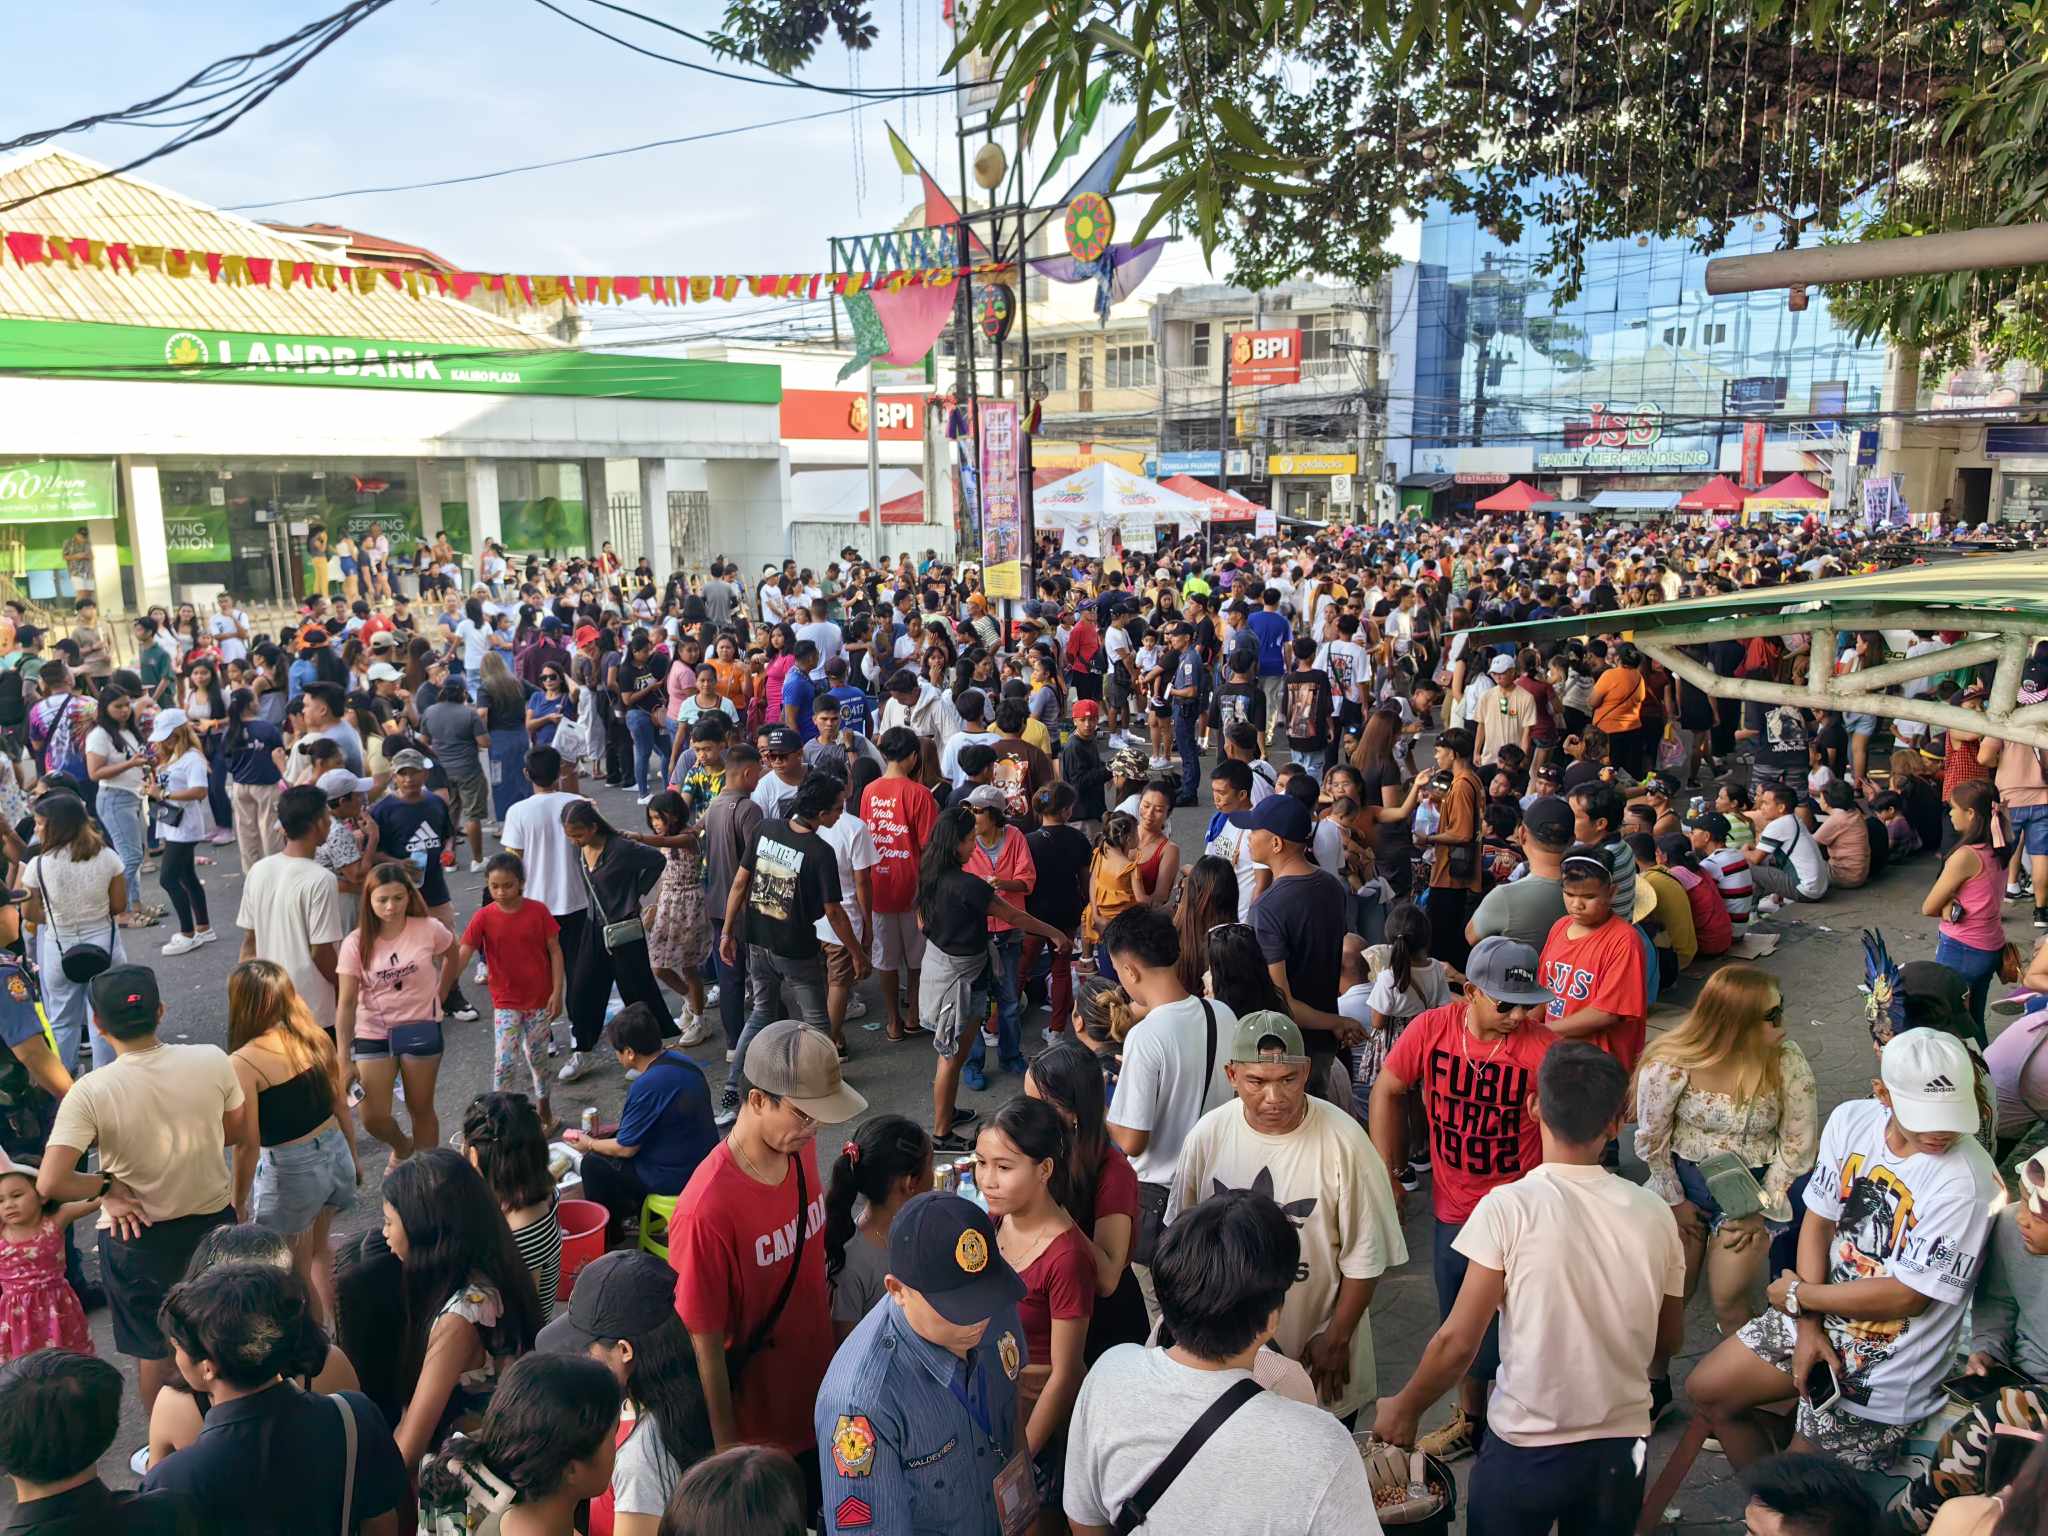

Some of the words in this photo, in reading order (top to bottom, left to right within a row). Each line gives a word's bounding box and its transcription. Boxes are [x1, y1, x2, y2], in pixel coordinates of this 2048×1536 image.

[1252, 336, 1289, 359] BPI
[218, 340, 442, 380] LANDBANK
[450, 369, 488, 382] KALIBO
[489, 371, 521, 383] PLAZA
[877, 402, 914, 428] BPI
[1540, 453, 1584, 466] FAMILY
[1590, 451, 1708, 466] MERCHANDISING
[348, 519, 405, 532] SERING
[871, 795, 897, 808] Don't
[872, 807, 894, 819] Hate
[406, 838, 442, 851] adas
[878, 846, 910, 859] Game
[1431, 1048, 1528, 1107] FUBU
[1430, 1089, 1521, 1137] CIRCA
[1433, 1123, 1521, 1175] 1992
[755, 1191, 827, 1267] CANDA
